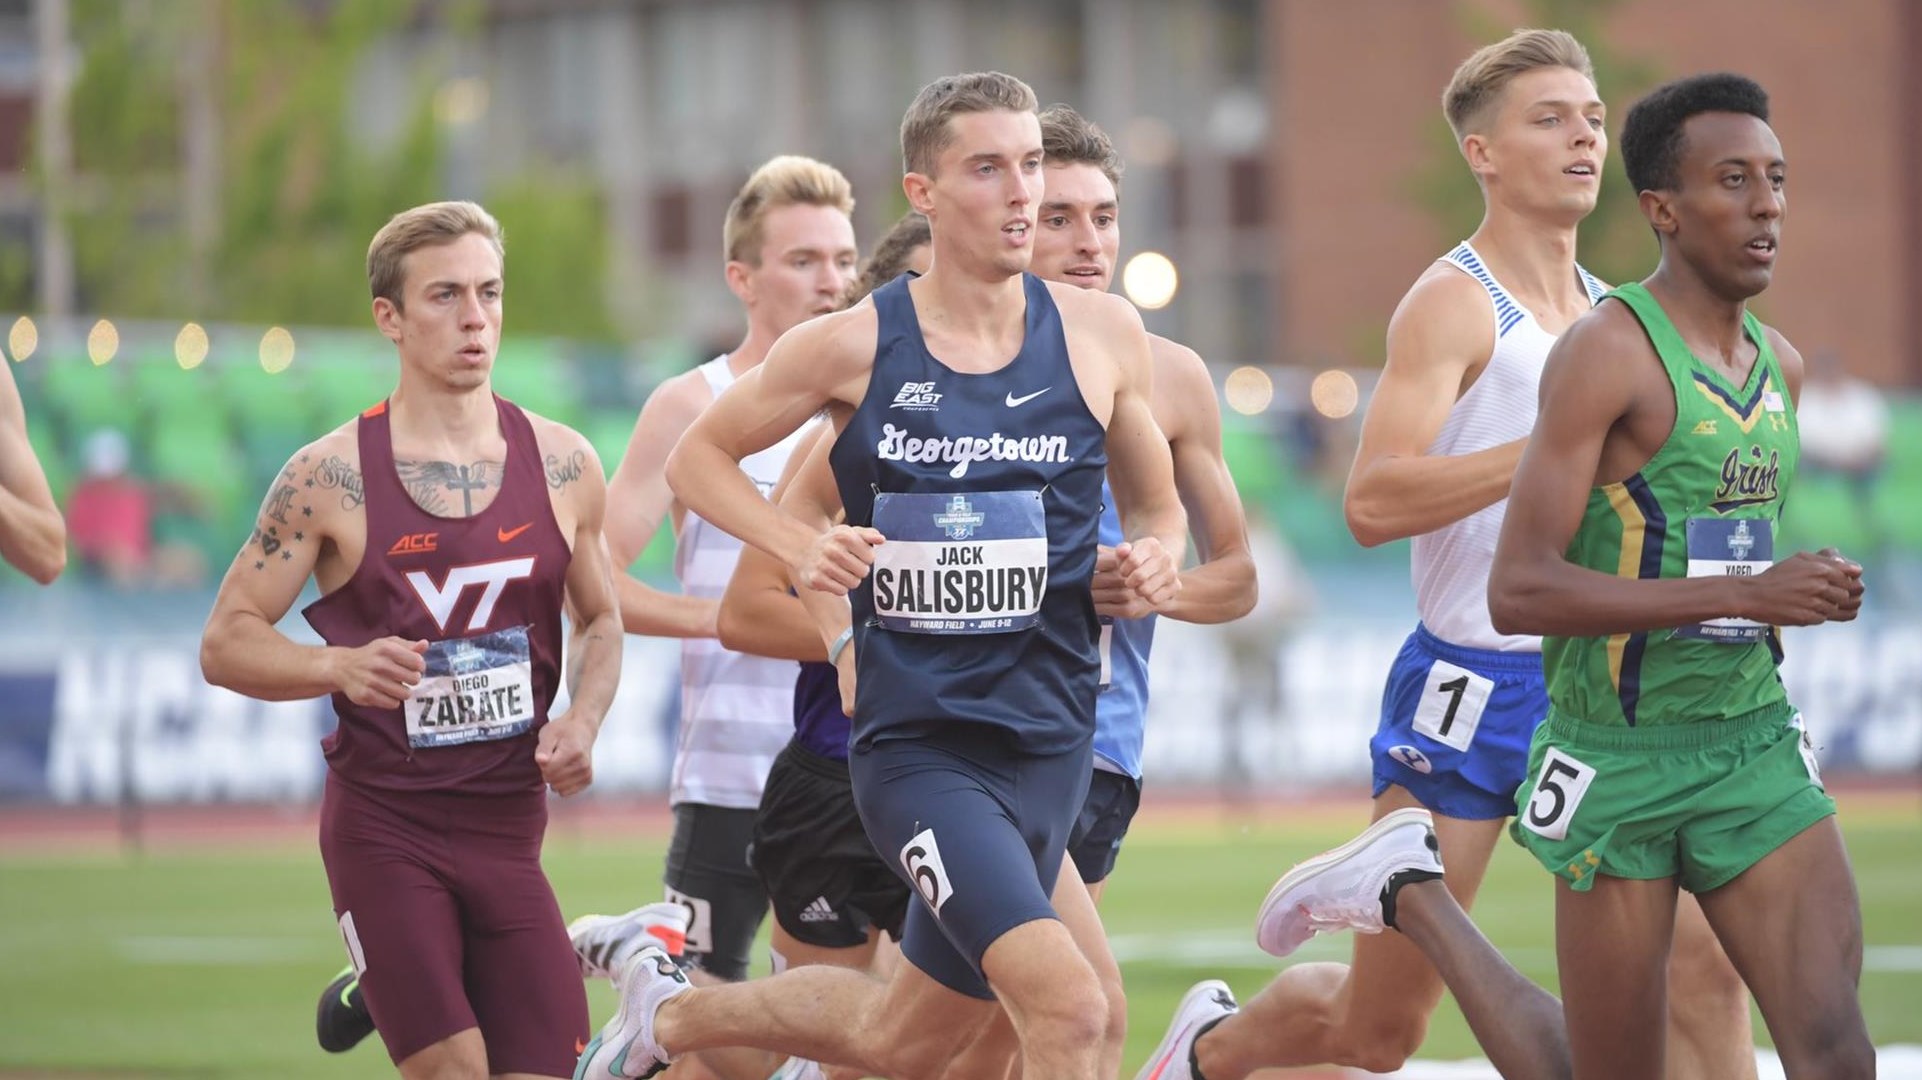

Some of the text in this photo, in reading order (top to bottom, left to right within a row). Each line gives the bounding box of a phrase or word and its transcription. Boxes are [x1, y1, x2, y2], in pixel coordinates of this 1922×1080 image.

[893, 392, 943, 404] EAST
[900, 381, 936, 394] BIG
[1715, 445, 1778, 499] Irish
[388, 533, 439, 555] ACC
[936, 546, 984, 566] JACK
[402, 554, 538, 636] VT
[876, 566, 1046, 614] SALISBURY
[945, 621, 965, 630] FIELD
[978, 619, 997, 629] JUNE
[416, 683, 523, 728] ZARATE
[452, 674, 489, 693] DIEGO
[1438, 675, 1470, 737] 1
[1529, 757, 1580, 828] 5
[905, 845, 939, 909] 6
